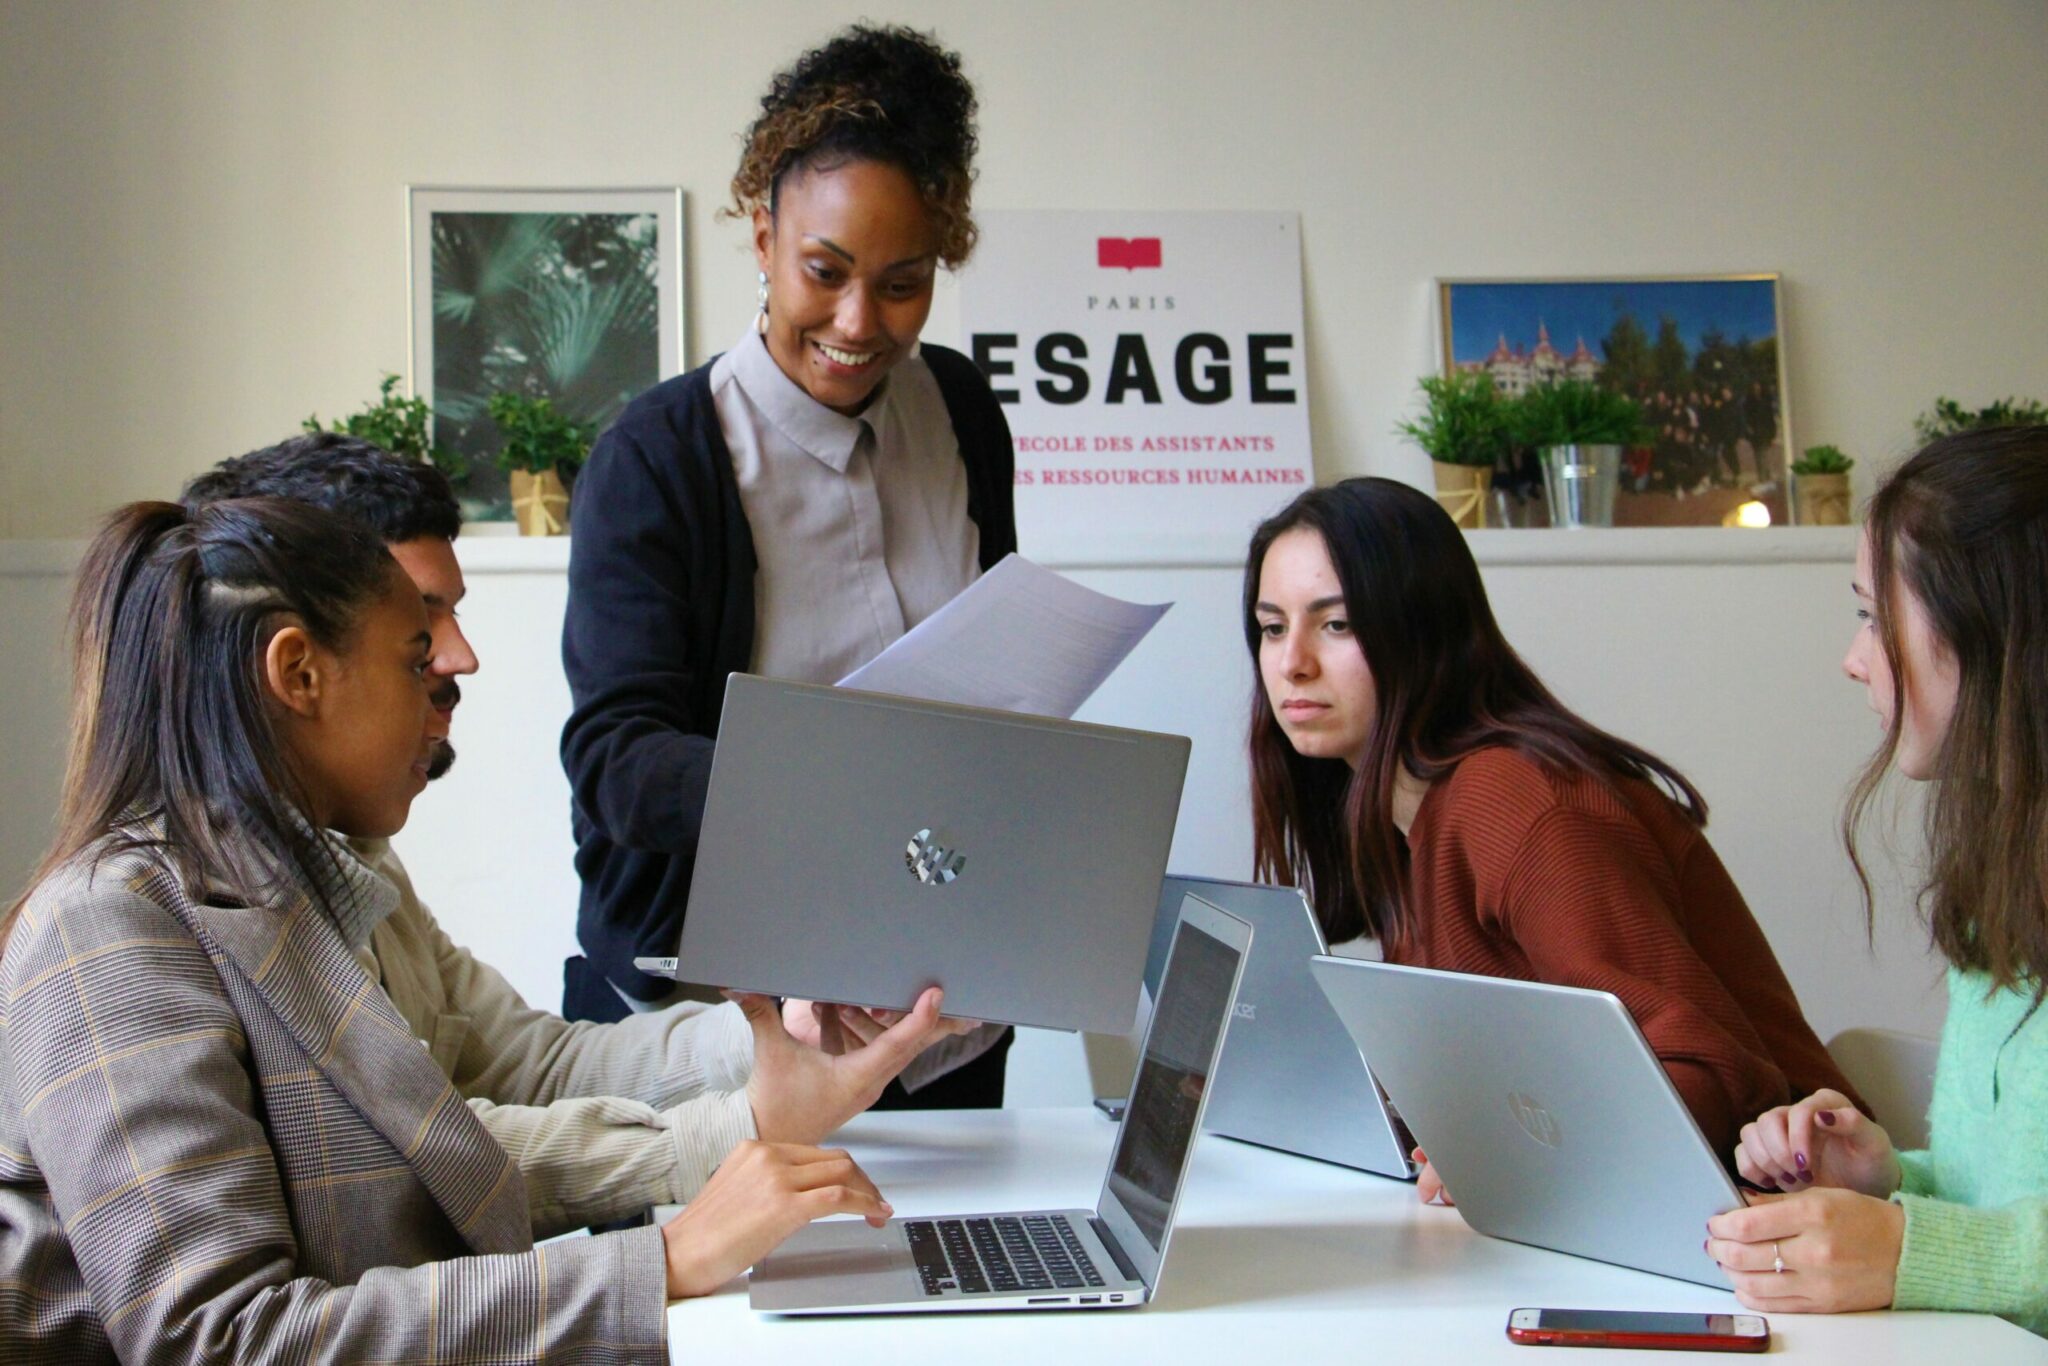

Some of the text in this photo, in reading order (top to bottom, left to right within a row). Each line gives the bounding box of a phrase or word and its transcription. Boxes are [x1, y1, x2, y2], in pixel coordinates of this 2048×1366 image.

[1087, 296, 1176, 310] PARIS
[971, 332, 1297, 405] ESAGE
[1094, 436, 1134, 452] DES
[1141, 436, 1275, 451] ASSISTANTS
[1014, 468, 1305, 485] ES RESSOURCES HUMAINES
